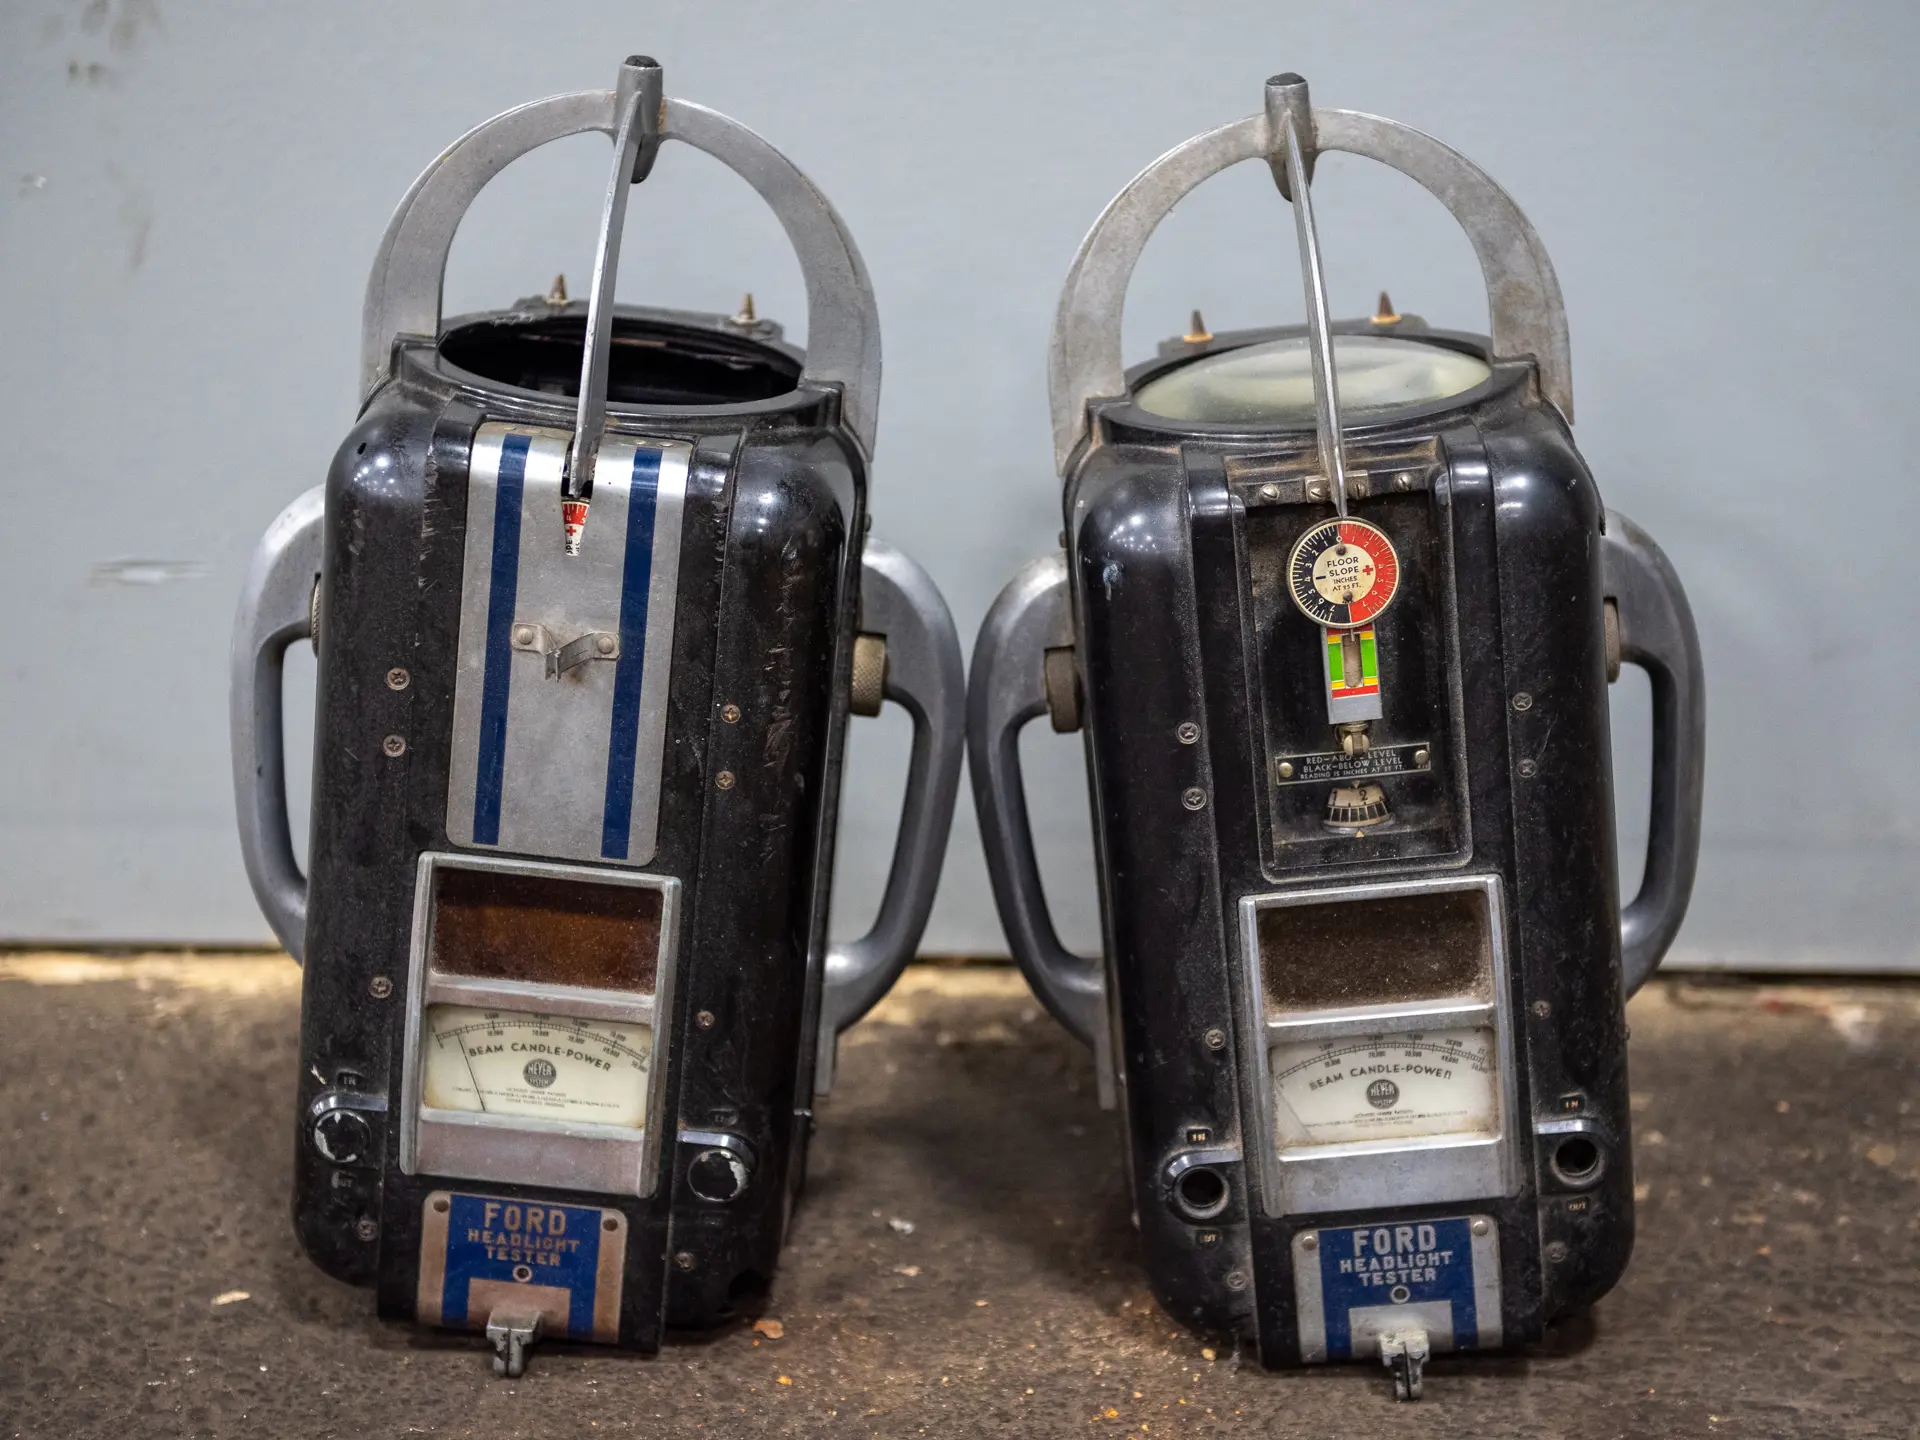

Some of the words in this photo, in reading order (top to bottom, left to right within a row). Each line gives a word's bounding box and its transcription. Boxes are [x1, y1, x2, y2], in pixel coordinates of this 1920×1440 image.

[1312, 549, 1319, 557] 2
[1363, 541, 1369, 549] 2
[1327, 556, 1359, 568] FLOOR
[1329, 566, 1360, 577] SLOPE
[1333, 576, 1358, 585] INCHES
[1303, 760, 1370, 773] BLACK-BELOW
[1375, 757, 1403, 767] LEVEL
[1306, 752, 1365, 765] RED-ABO
[1368, 749, 1397, 759] LEVEL
[1343, 768, 1368, 776] INCHES
[1359, 789, 1369, 802] 2
[468, 1043, 504, 1057] BEAM
[511, 1042, 612, 1072] CANDLE-POWER
[1309, 1073, 1344, 1091] BEAM
[1350, 1064, 1453, 1080] CANDLE-POWER
[1565, 1100, 1579, 1108] IN
[484, 1201, 567, 1236] FORD
[467, 1227, 580, 1254] HEADLIGHT
[1353, 1224, 1437, 1257] FORD
[485, 1245, 561, 1266] TESTER
[1340, 1250, 1454, 1274] HEADLIGHT
[1358, 1267, 1437, 1287] TESTER
